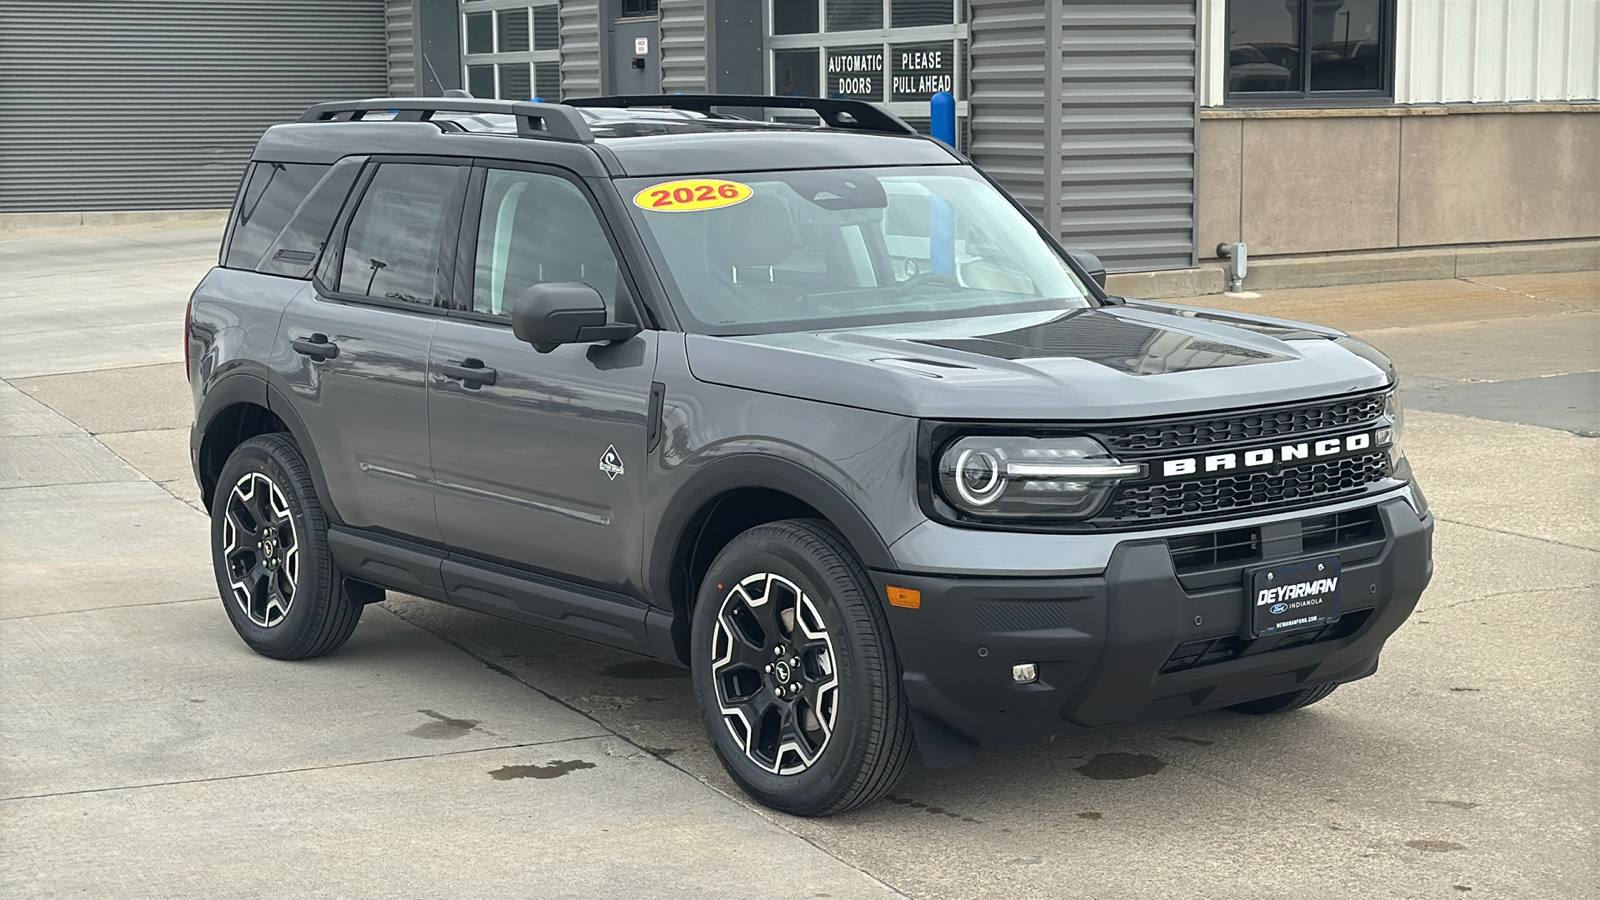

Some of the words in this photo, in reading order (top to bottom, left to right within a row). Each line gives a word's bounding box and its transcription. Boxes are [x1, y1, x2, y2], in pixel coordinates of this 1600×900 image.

[828, 54, 882, 72] AUTOMATIC
[902, 51, 942, 70] PLEASE
[839, 77, 872, 94] DOORS
[893, 76, 916, 93] PULL
[918, 74, 951, 93] AHEAD
[650, 184, 739, 207] 2026
[1163, 433, 1370, 477] BRONCO
[1257, 577, 1338, 606] DEYARMAN
[1289, 598, 1323, 609] INDIANOLA
